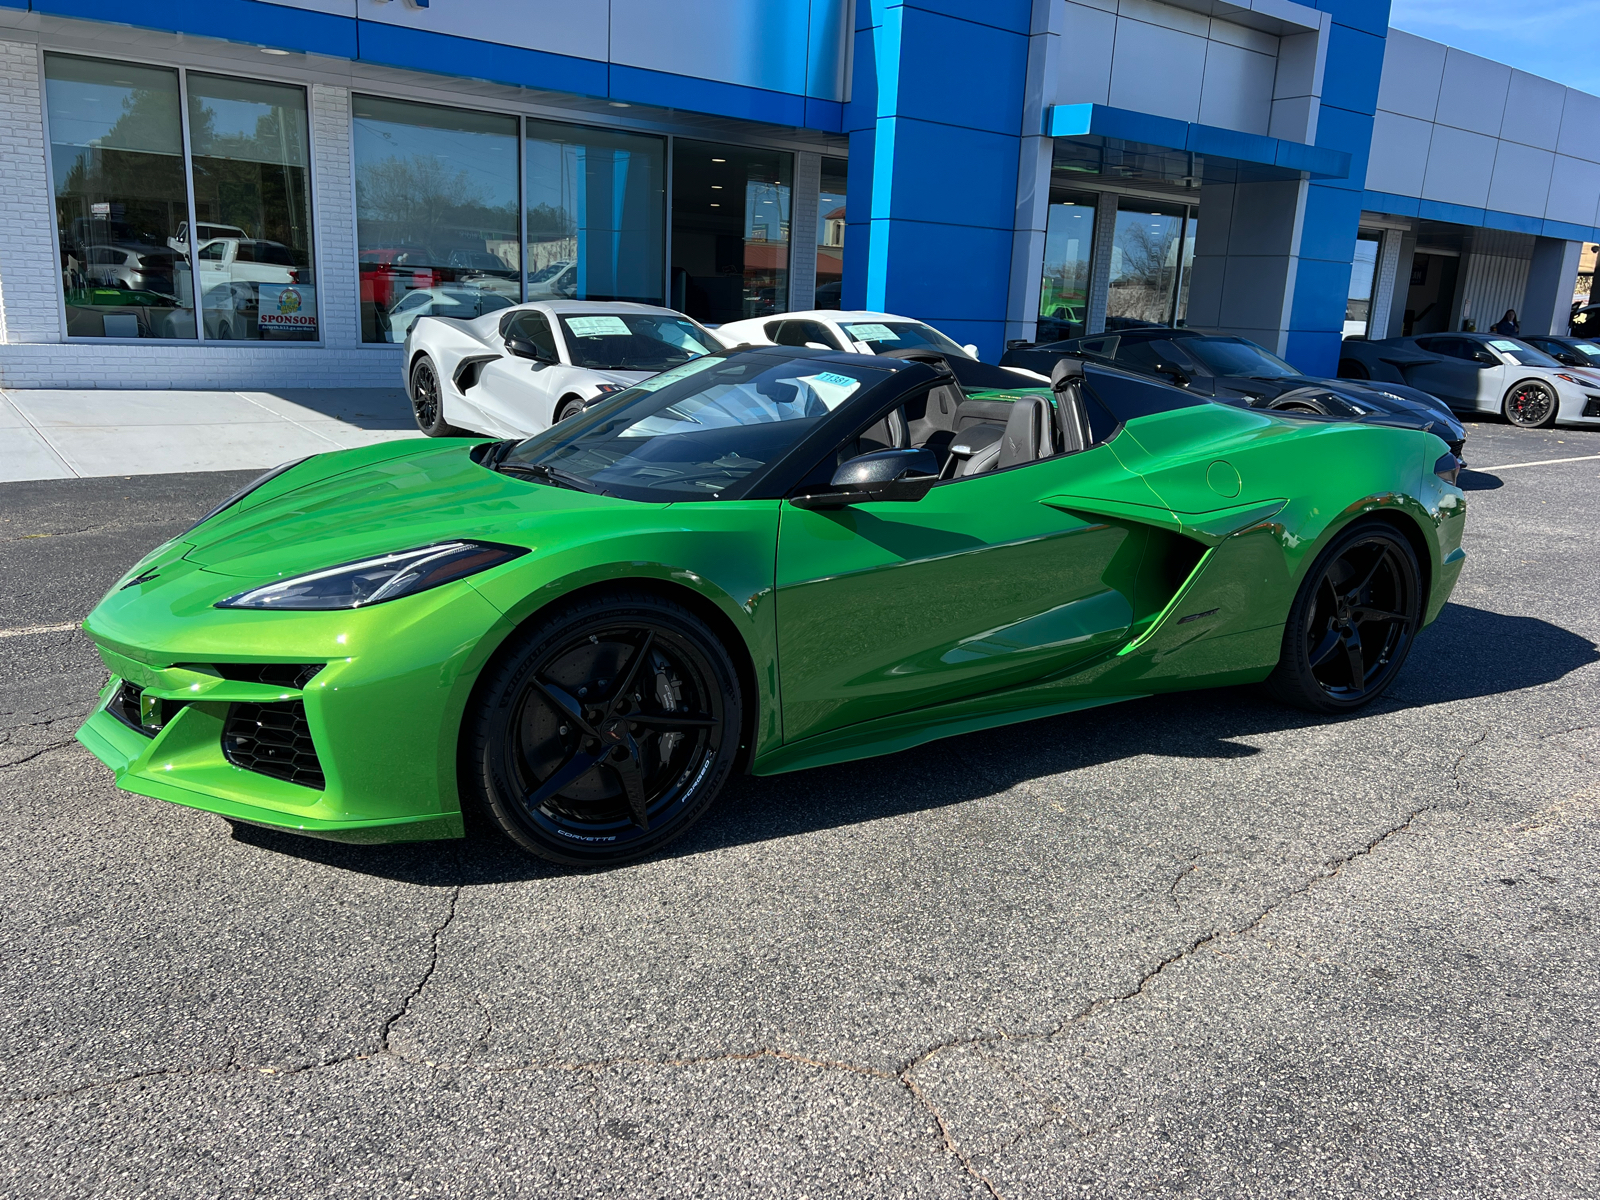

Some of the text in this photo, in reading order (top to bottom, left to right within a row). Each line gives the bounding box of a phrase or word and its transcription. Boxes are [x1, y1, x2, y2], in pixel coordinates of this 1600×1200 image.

[261, 315, 316, 325] SPONSOR
[820, 373, 850, 385] T1381
[508, 643, 546, 693] MICHELIN
[586, 615, 597, 623] ALL
[598, 610, 622, 619] SEASON
[681, 760, 710, 803] FORGED
[688, 772, 722, 820] MICHELIN
[557, 829, 617, 842] CORVETTE
